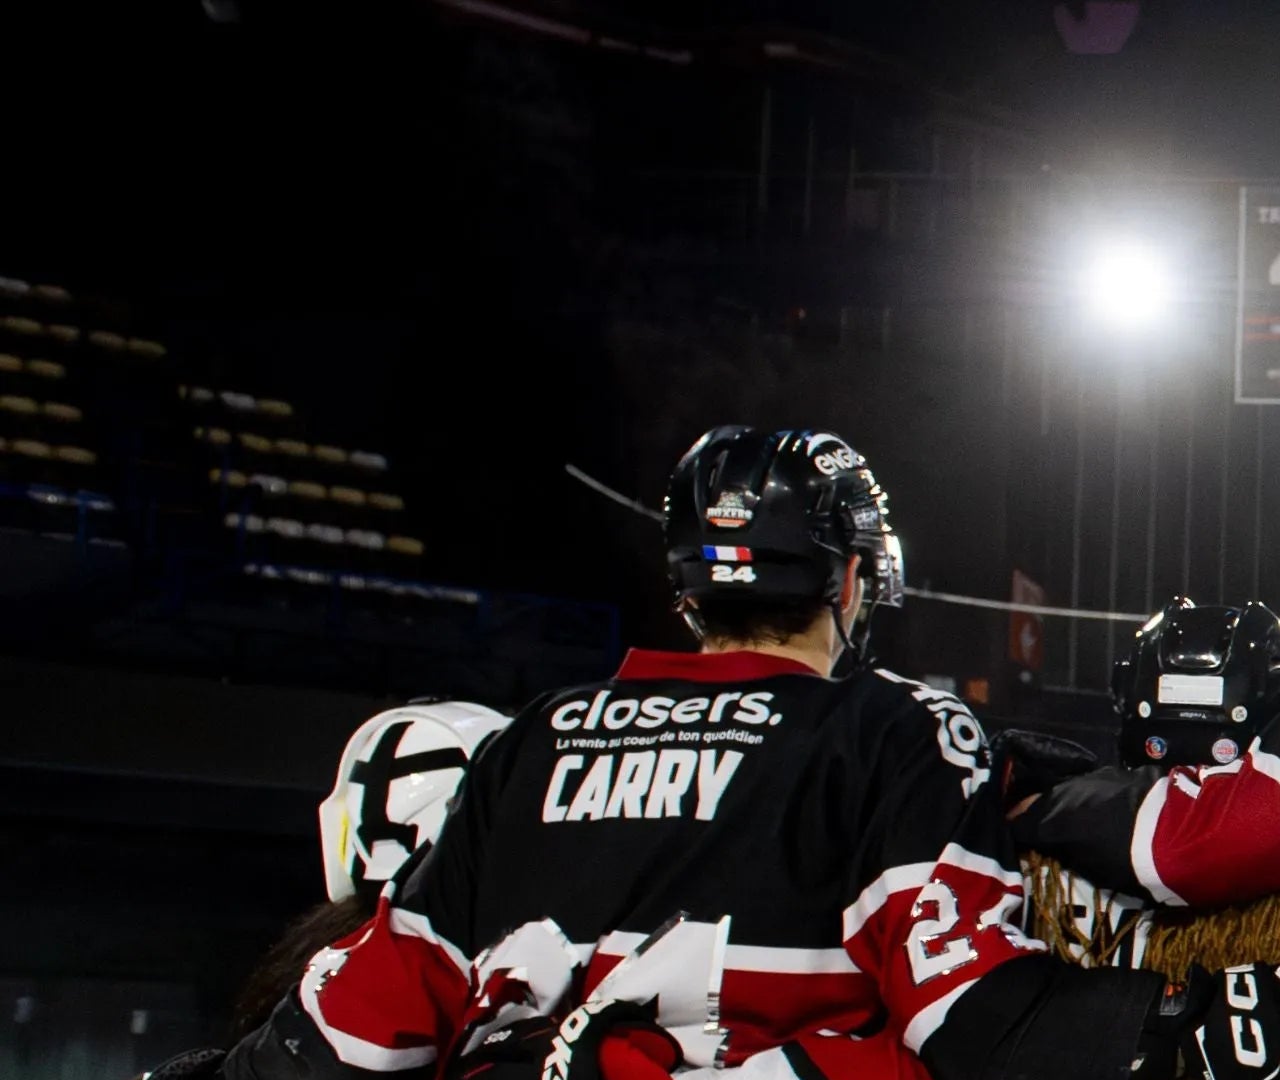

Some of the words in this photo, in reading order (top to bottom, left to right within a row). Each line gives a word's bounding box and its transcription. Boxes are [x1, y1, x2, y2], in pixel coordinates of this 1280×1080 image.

[711, 564, 756, 583] 24
[550, 689, 783, 731] closers.
[572, 738, 607, 750] vente
[623, 734, 659, 747] coeur
[678, 730, 700, 742] ton
[703, 728, 764, 745] quotidien
[541, 749, 745, 824] CARRY
